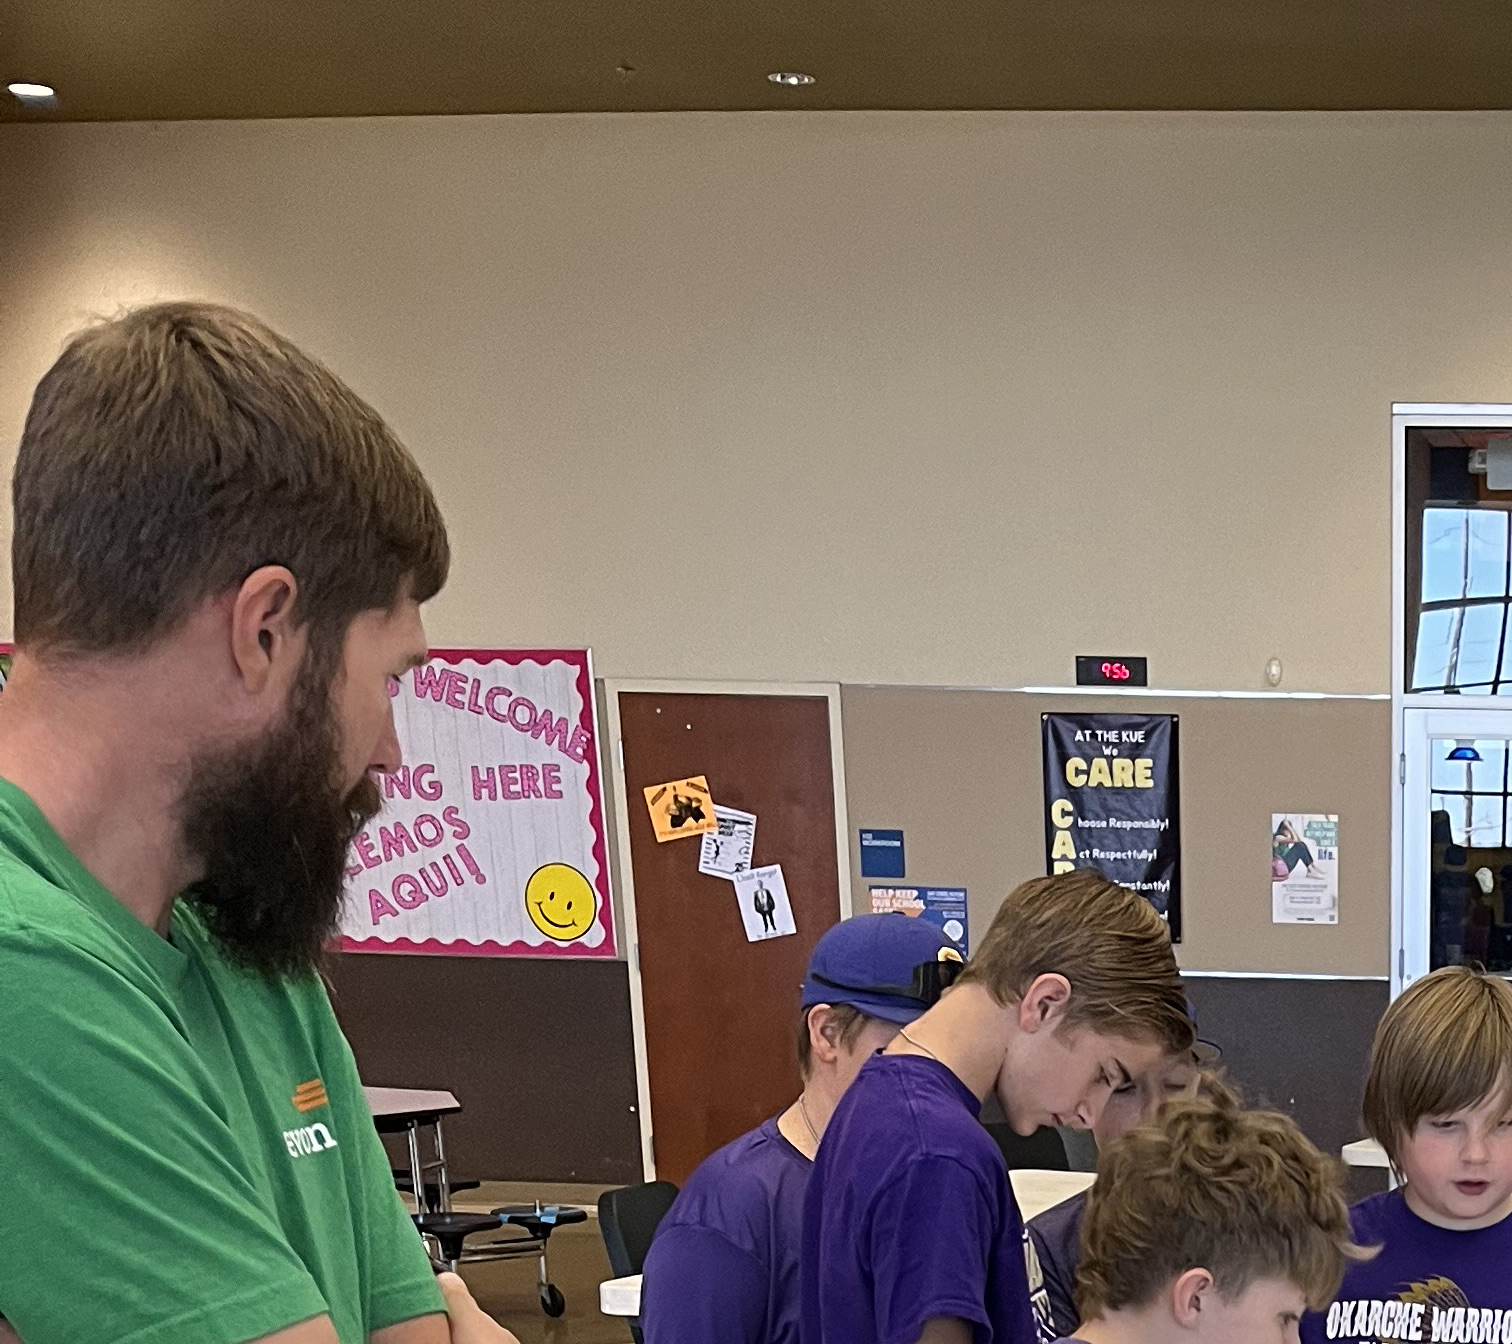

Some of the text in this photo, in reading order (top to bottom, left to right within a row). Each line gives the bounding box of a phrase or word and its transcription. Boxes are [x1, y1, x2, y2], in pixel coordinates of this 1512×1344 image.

[412, 665, 592, 764] WELCOME
[1074, 730, 1146, 743] AT THE KUE
[471, 763, 563, 801] HERE
[1065, 756, 1154, 788] CARE
[1109, 817, 1169, 831] Responsibly!
[1092, 848, 1157, 861] Respectfully!
[367, 843, 486, 926] AQUI!
[1326, 1299, 1425, 1341] OKARCHE
